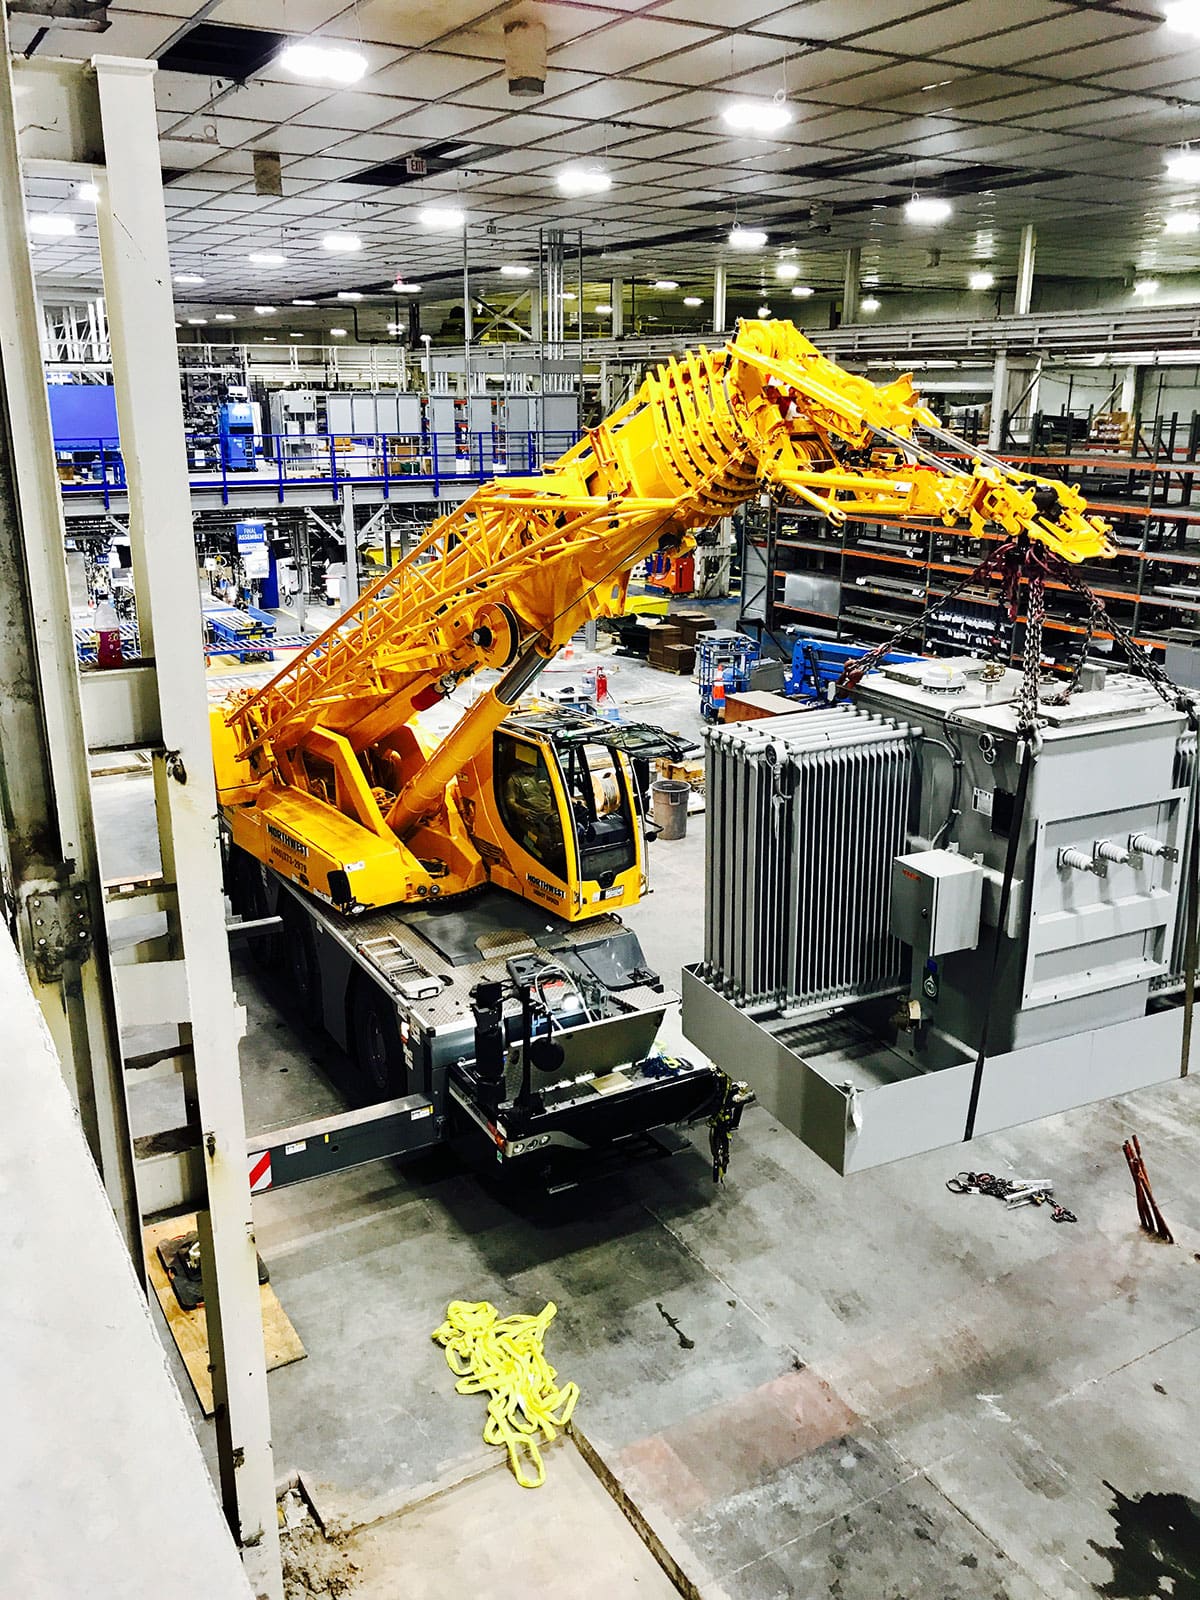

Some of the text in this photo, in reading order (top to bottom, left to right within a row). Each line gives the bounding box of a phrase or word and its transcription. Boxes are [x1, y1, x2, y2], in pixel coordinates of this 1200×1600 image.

[411, 160, 424, 171] EXIT
[487, 225, 496, 234] EXIT
[267, 824, 309, 857] NORTHWEST
[526, 872, 565, 899] NORTHWEST
